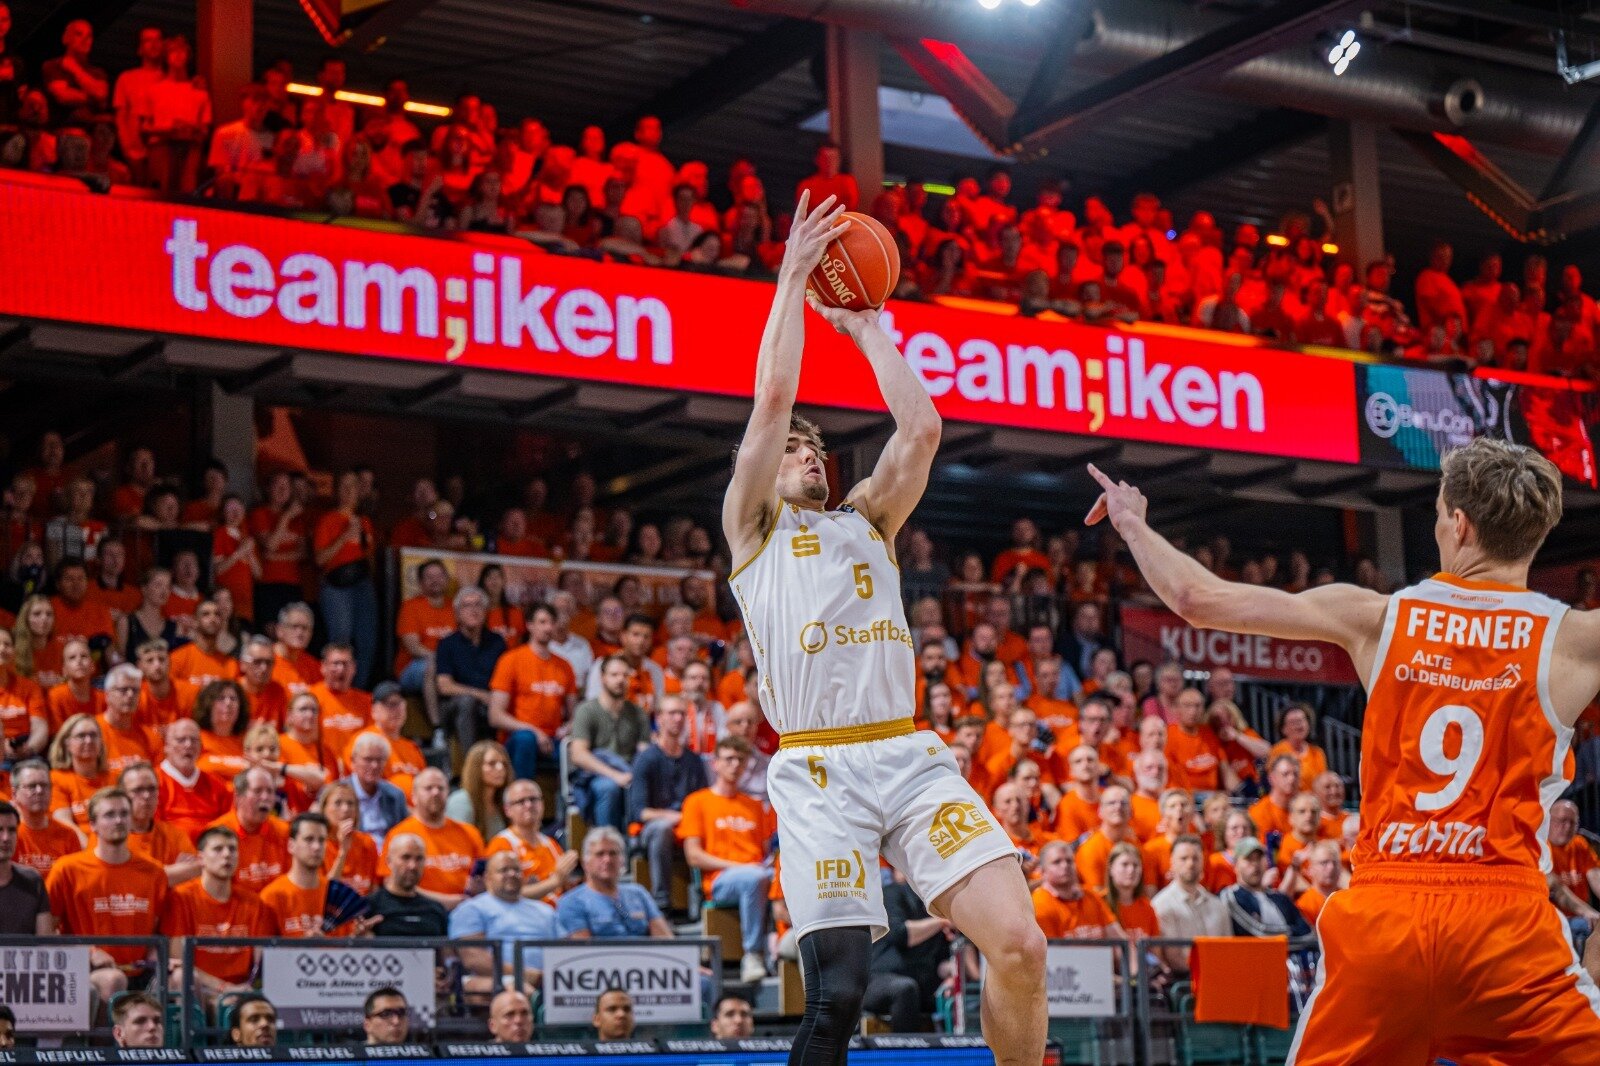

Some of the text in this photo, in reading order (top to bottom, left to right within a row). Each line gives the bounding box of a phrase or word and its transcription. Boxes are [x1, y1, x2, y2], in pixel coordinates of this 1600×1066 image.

[165, 219, 673, 364] team;iken
[853, 563, 874, 599] 5
[1407, 607, 1534, 650] FERNER
[1411, 650, 1452, 670] ALTE
[1395, 664, 1514, 692] OLDENBURGER
[807, 755, 828, 789] 5
[1414, 704, 1484, 811] 9
[816, 859, 851, 880] IFD
[817, 881, 851, 890] WE THINK
[817, 891, 848, 900] AROUND
[0, 972, 66, 1003] MER
[553, 968, 692, 991] NEMANN
